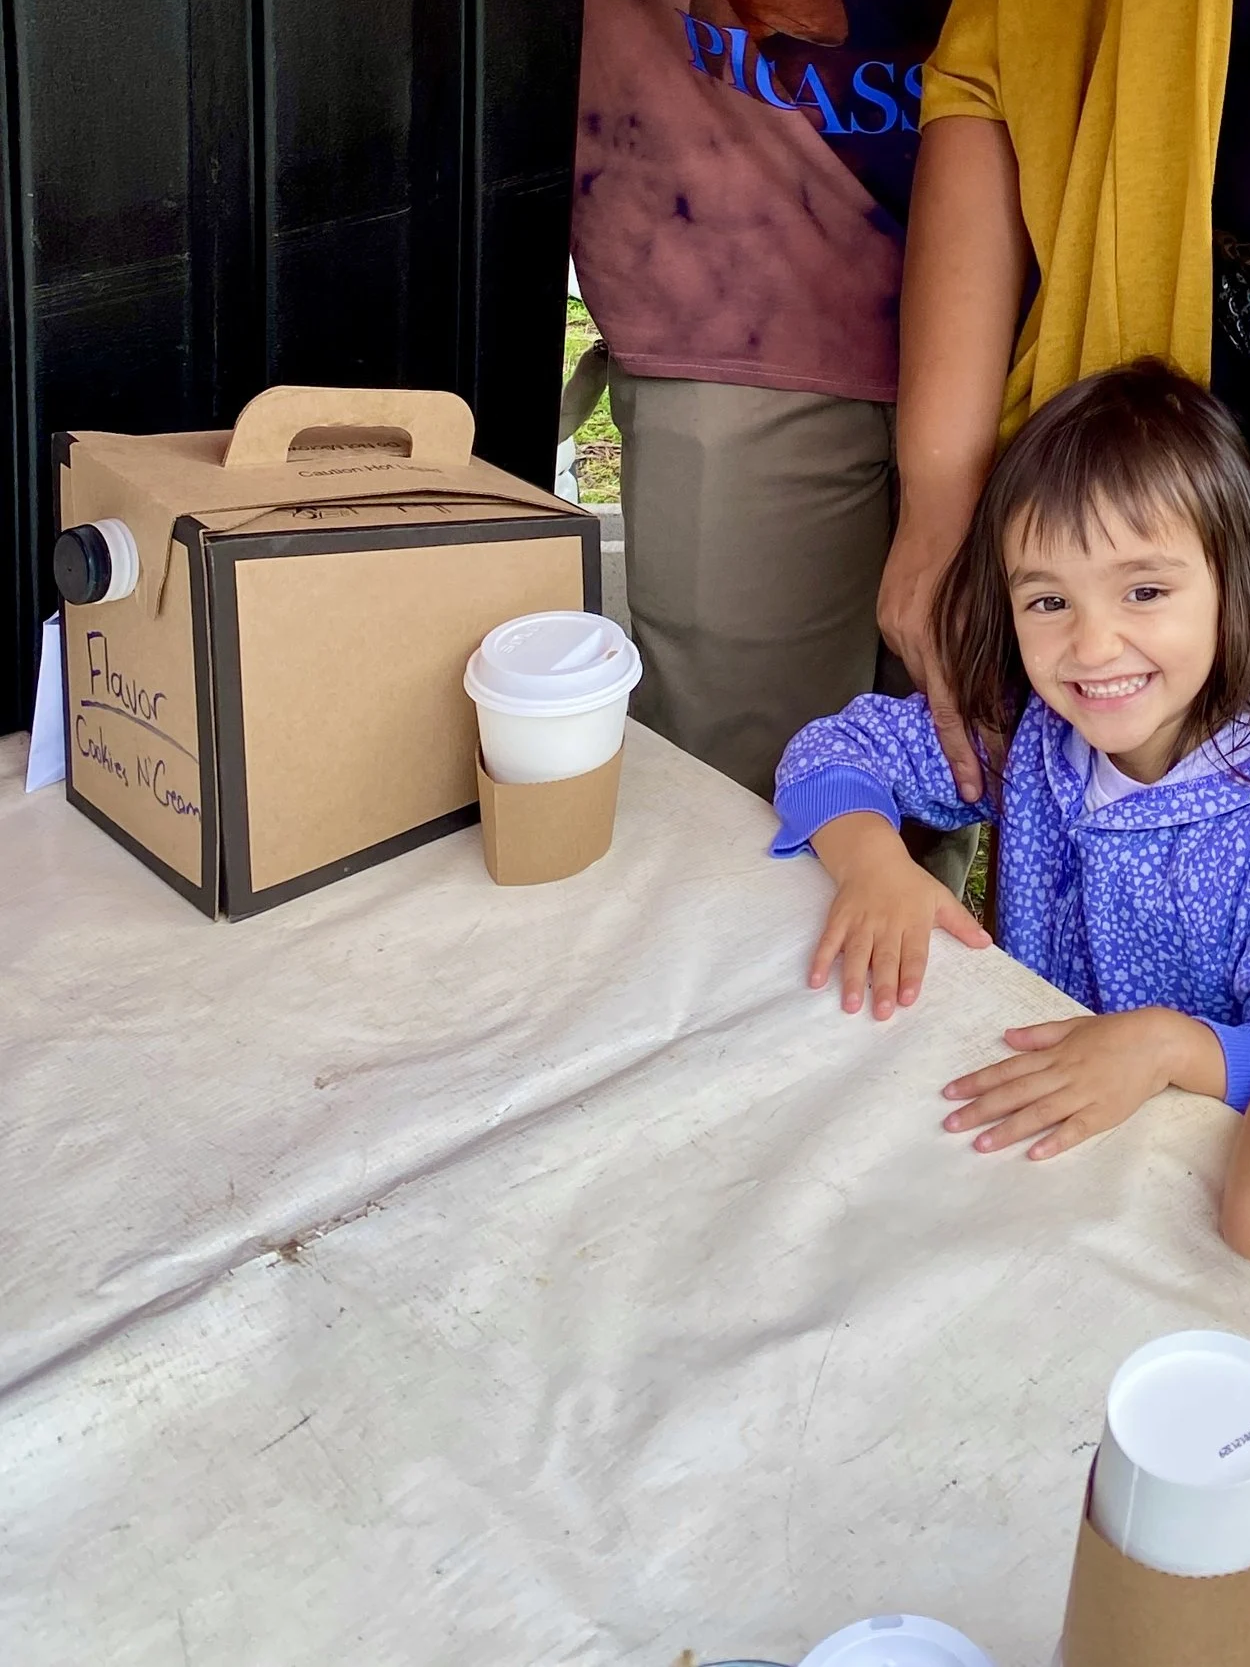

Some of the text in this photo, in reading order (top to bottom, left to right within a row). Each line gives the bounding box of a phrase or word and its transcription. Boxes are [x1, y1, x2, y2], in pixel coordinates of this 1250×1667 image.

[298, 466, 361, 478] Caution
[364, 463, 393, 472] Hot
[87, 631, 167, 720] Flavor
[75, 715, 129, 787] Cookies
